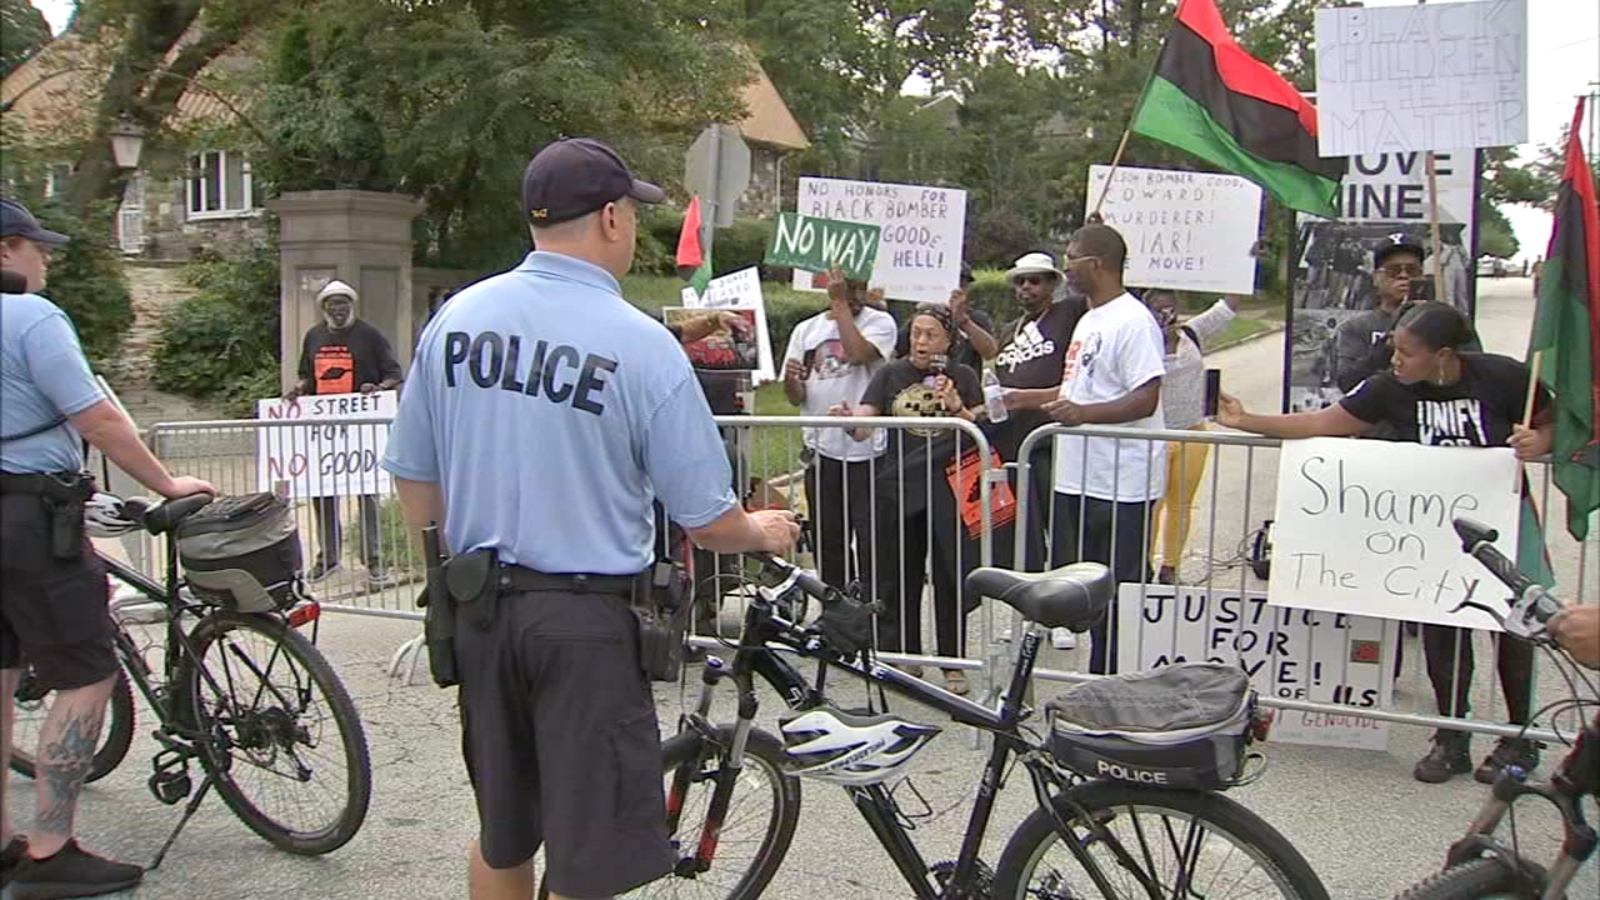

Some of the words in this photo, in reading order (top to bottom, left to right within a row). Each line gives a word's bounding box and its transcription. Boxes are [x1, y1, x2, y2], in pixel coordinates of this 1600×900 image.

[1337, 1, 1511, 45] BLACK
[1319, 34, 1521, 82] CHILDREN
[1331, 100, 1524, 154] MATTER
[1096, 170, 1140, 183] WLSON
[1355, 151, 1453, 176] OVE
[808, 181, 829, 196] NO
[845, 184, 899, 199] HONORS
[921, 189, 948, 203] FOR
[1104, 187, 1216, 205] COWARD!
[1334, 184, 1424, 219] INE
[812, 198, 874, 220] BLACK
[885, 199, 948, 219] BOMBER
[1105, 210, 1215, 225] MURDERER!
[773, 213, 815, 255] NO
[1140, 229, 1192, 255] IAR!
[893, 250, 944, 268] HELL!
[1148, 256, 1205, 271] MOVE!
[996, 339, 1055, 368] adidas
[444, 330, 619, 416] POLICE
[268, 401, 301, 419] NO
[313, 394, 382, 415] STREET
[1416, 398, 1487, 446] UNIFY
[270, 453, 307, 479] NO
[1300, 455, 1479, 528] Shame
[1365, 531, 1425, 561] on
[1290, 552, 1359, 590] The
[1384, 565, 1480, 604] City
[1143, 594, 1352, 629] JUSTICE
[1211, 627, 1290, 657] FOR
[1152, 655, 1321, 686] VE!
[1278, 687, 1306, 699] OF
[1097, 759, 1169, 785] POLICE
